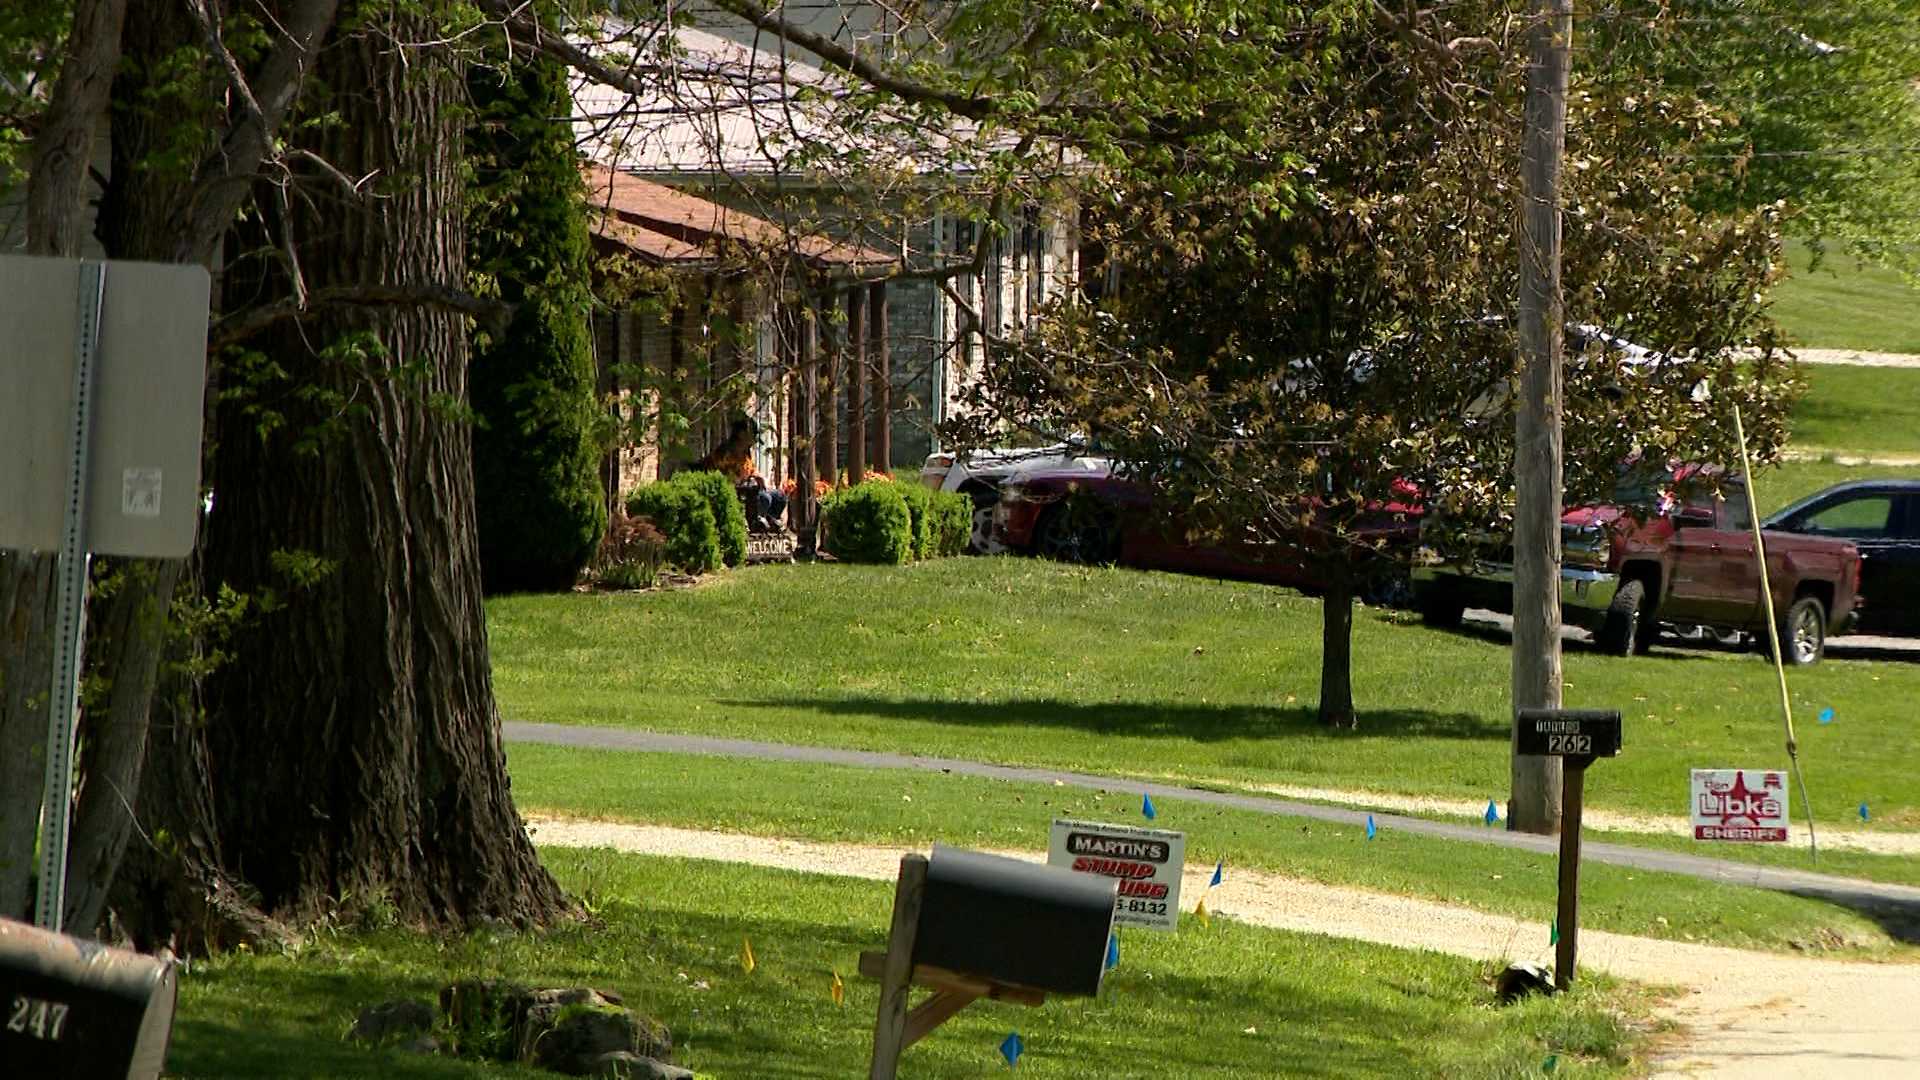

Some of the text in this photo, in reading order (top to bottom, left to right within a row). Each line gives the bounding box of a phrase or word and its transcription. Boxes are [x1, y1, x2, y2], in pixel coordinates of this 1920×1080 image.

[1549, 735, 1590, 753] 262
[1699, 793, 1781, 818] Libka
[1702, 827, 1778, 839] SHERIFF
[1075, 837, 1162, 858] MARTIN'S
[1072, 856, 1156, 879] STUMP
[7, 996, 69, 1040] 247
